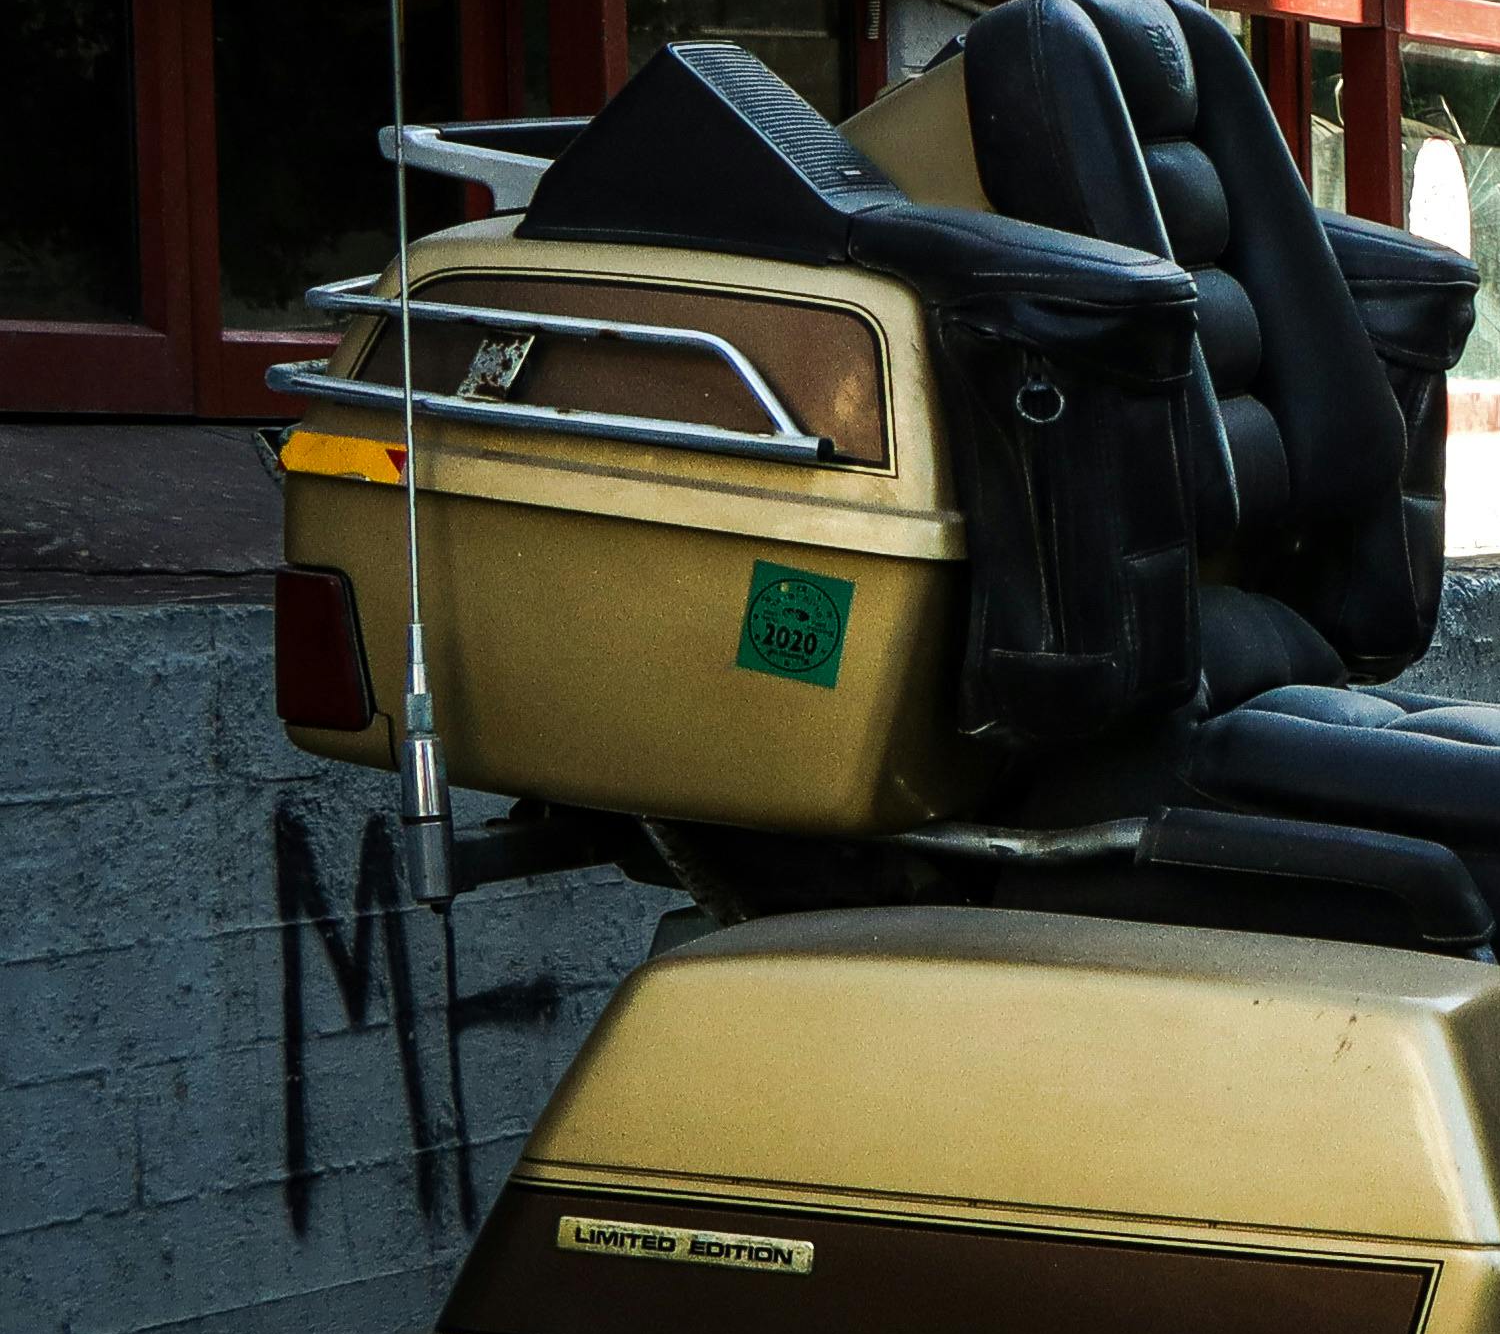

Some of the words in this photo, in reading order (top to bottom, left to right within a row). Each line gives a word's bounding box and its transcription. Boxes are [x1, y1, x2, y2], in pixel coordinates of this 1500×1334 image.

[763, 623, 818, 655] 2020
[574, 1226, 677, 1253] LIMITED
[687, 1239, 794, 1265] EDITION
